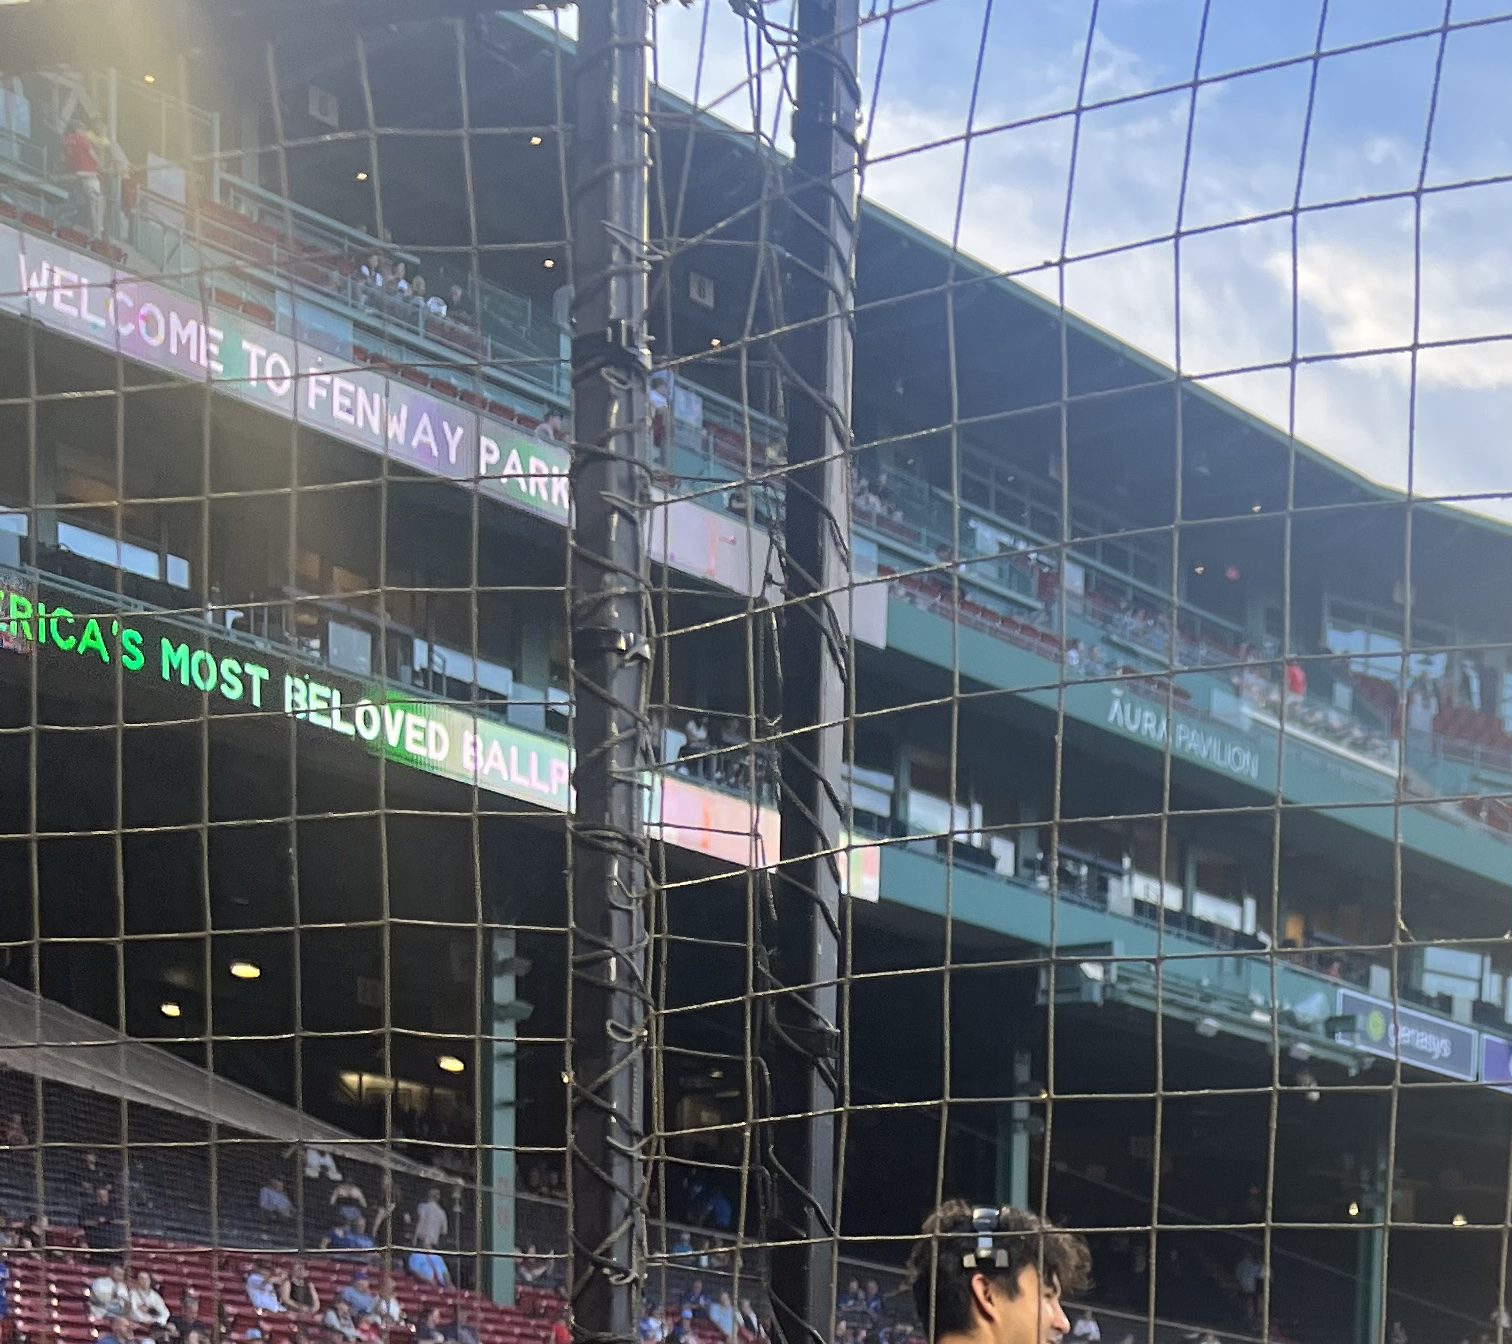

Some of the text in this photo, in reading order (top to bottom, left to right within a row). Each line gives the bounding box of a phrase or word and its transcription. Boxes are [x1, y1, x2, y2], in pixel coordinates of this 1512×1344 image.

[19, 252, 569, 510] WELCOME TO FENWAY PARK
[0, 590, 146, 671] RICA'S
[160, 636, 270, 708] MOST
[284, 673, 449, 762] BELOVED
[1175, 723, 1260, 781] PAVILION
[1388, 1022, 1452, 1060] genasys
